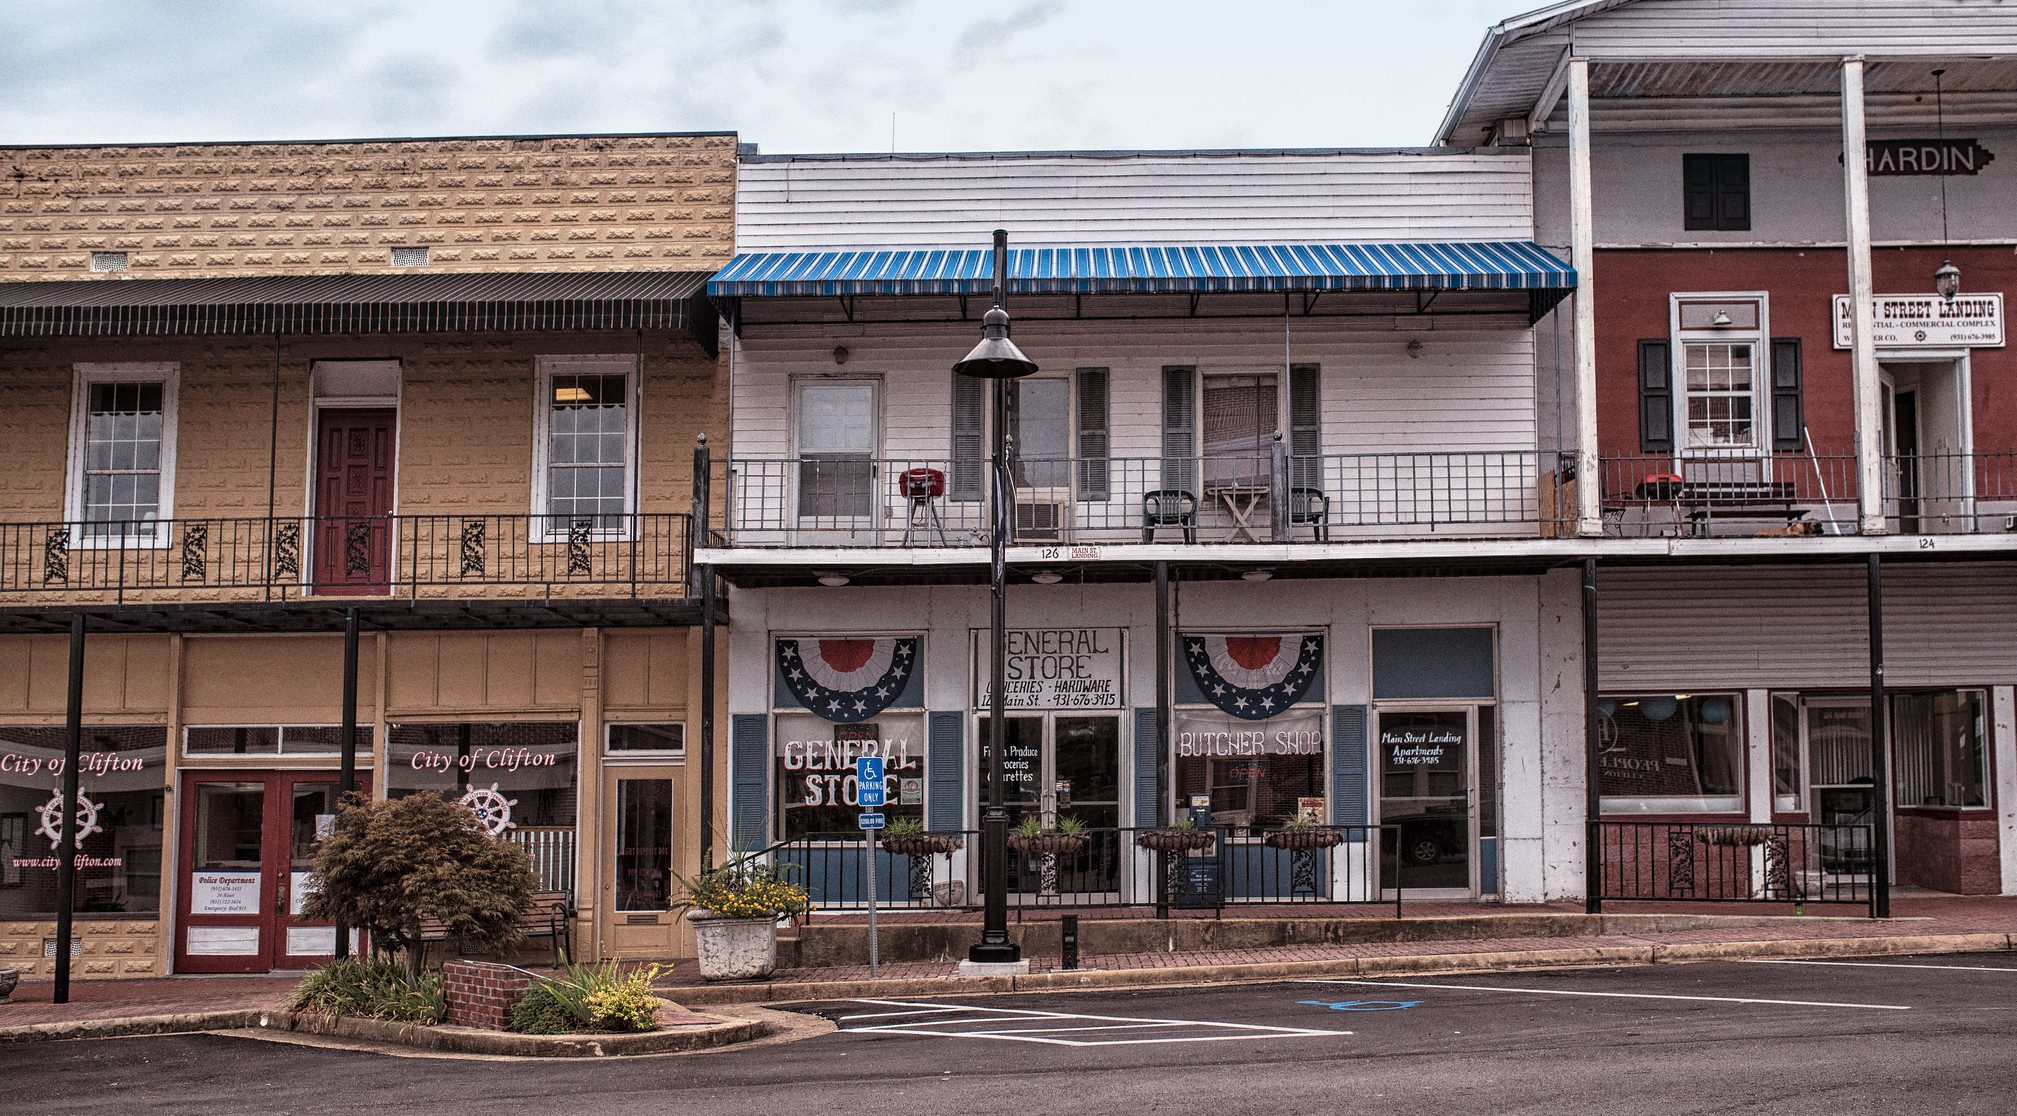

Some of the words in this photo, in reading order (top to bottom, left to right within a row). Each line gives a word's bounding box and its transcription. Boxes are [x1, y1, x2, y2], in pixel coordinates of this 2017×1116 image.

[1884, 301, 1932, 319] STREET
[1939, 300, 1995, 318] LANDING
[1900, 320, 1956, 328] COMMERCIAL
[1957, 319, 1996, 328] COMPLEX
[1950, 333, 1967, 341] (931)
[1919, 538, 1935, 549] 124
[1042, 548, 1059, 559] 126
[1003, 630, 1109, 655] ENERAL
[1007, 655, 1092, 680] STORE
[1054, 679, 1112, 693] HARDWARE
[1026, 694, 1041, 706] St.
[1180, 732, 1265, 757] BUTCHER
[1275, 731, 1322, 755] SHOP
[1381, 732, 1403, 744] Main
[1404, 732, 1426, 743] Street
[1428, 732, 1462, 744] Landing
[784, 739, 917, 771] GENERAL
[1010, 745, 1039, 757] Produce
[1392, 745, 1444, 757] Apartments
[1, 754, 42, 776] City
[78, 752, 144, 776] Clifton
[411, 751, 452, 773] City
[459, 748, 484, 773] of
[486, 747, 556, 772] Clifton
[1230, 768, 1265, 778] OPEN
[805, 774, 898, 807] STOE
[859, 781, 883, 790] PARKING
[864, 792, 879, 802] ONLY
[199, 876, 218, 884] Police
[219, 876, 255, 886] Department
